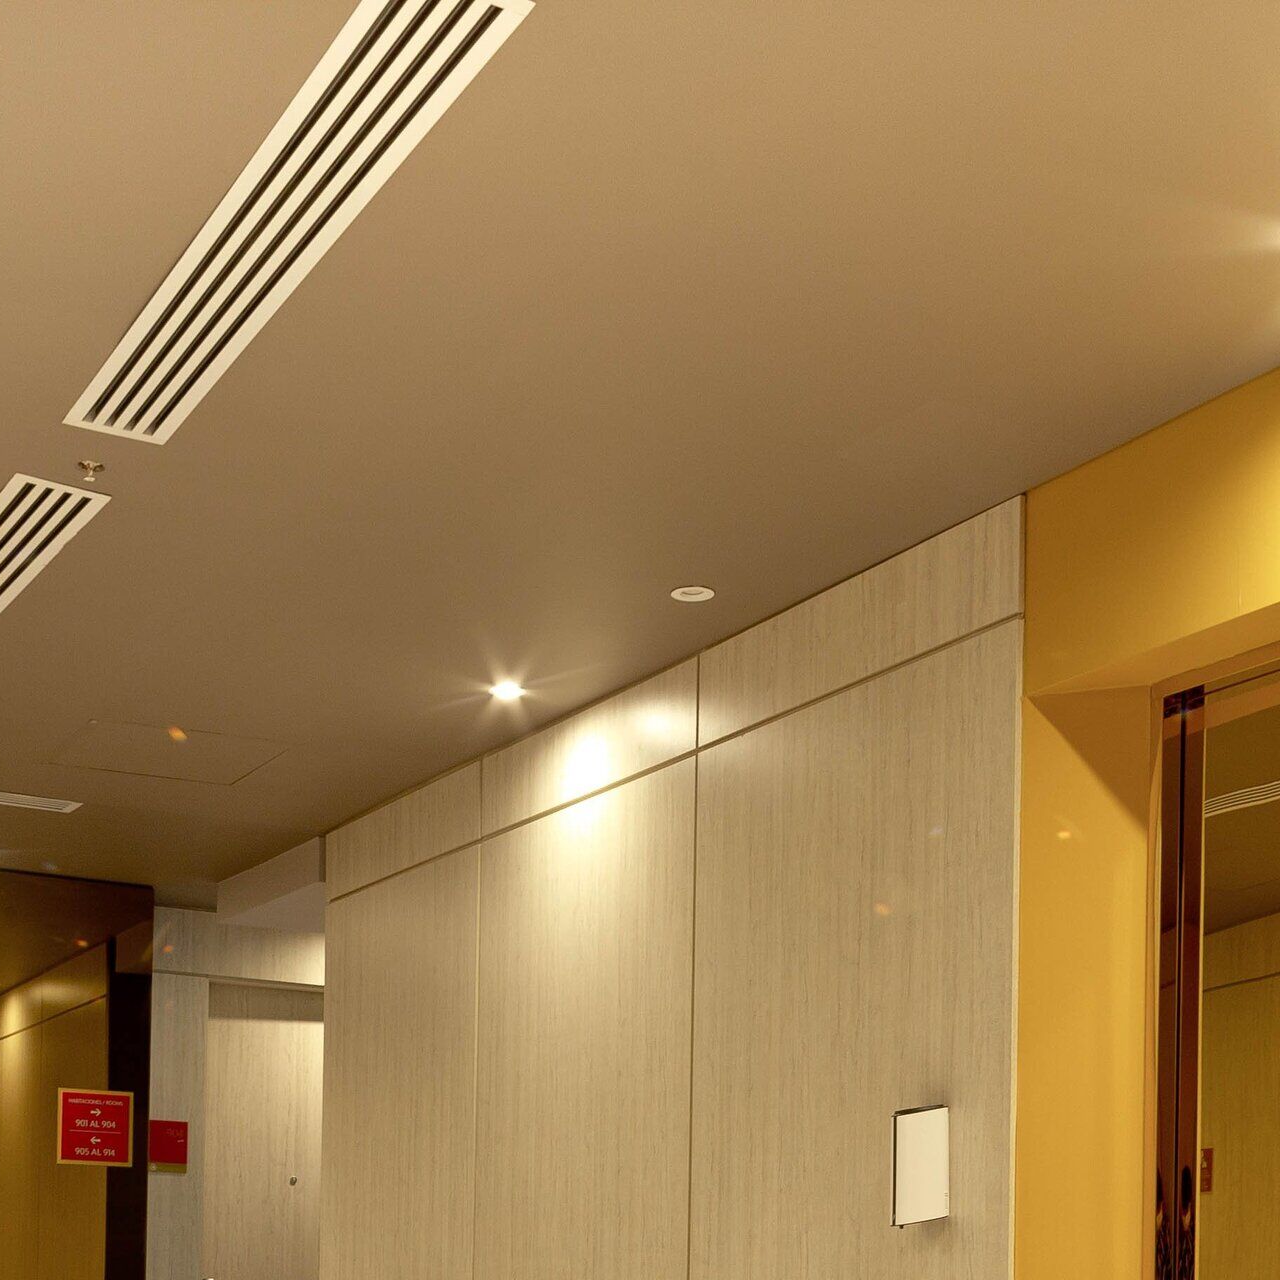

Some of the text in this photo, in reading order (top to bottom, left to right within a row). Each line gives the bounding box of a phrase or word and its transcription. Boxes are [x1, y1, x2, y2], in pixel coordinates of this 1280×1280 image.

[75, 1119, 116, 1128] 901 AL 904
[74, 1147, 90, 1156] 905
[90, 1148, 102, 1156] AL
